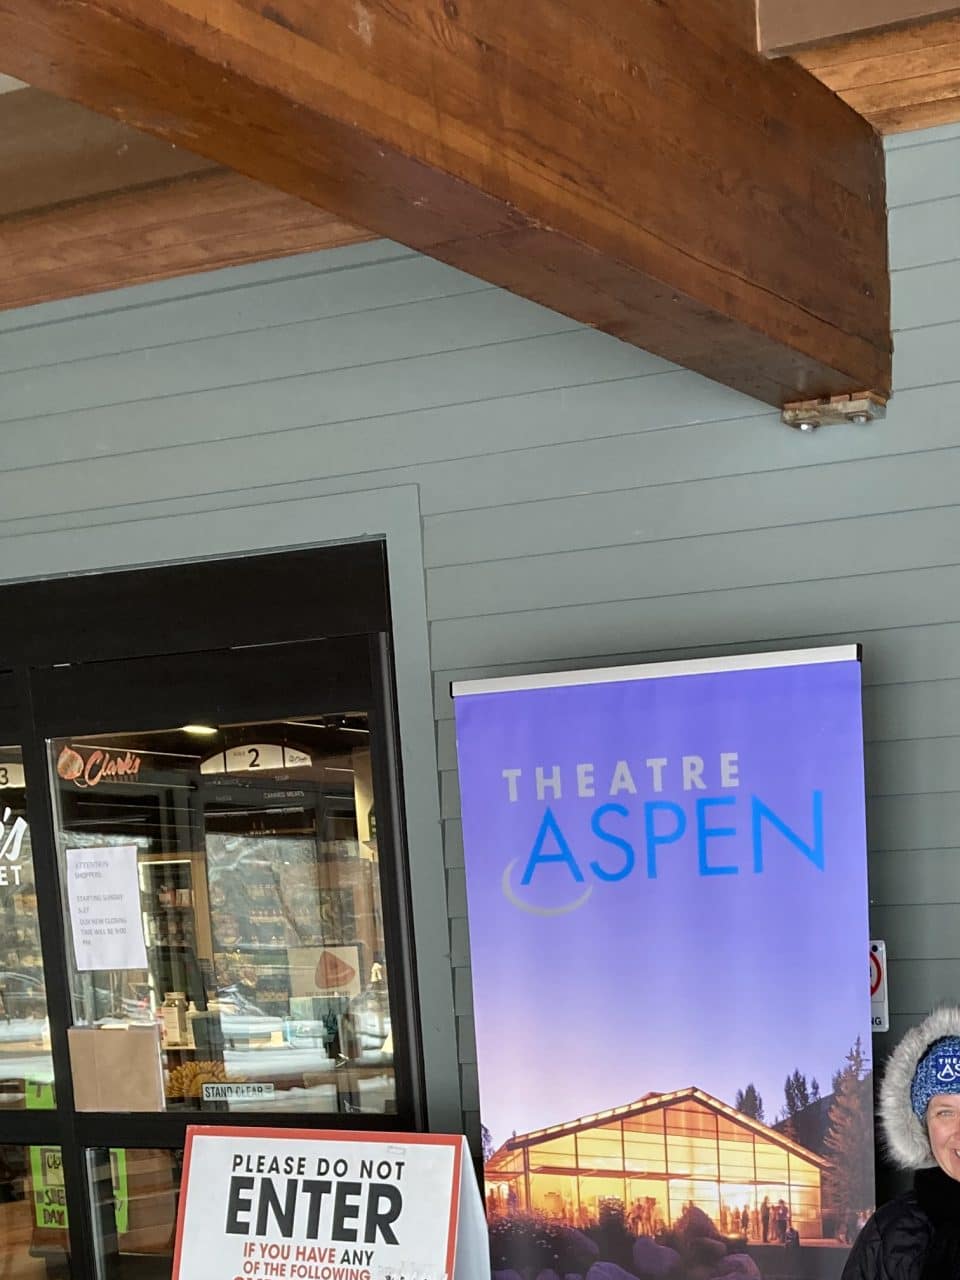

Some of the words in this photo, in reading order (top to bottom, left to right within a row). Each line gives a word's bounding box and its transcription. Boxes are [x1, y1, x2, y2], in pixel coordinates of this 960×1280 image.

[85, 750, 141, 786] Clark's
[248, 748, 260, 767] 2
[502, 753, 740, 802] THEATRE
[521, 790, 824, 887] ASPEN
[232, 1154, 306, 1176] PLEASE
[317, 1158, 348, 1178] DO
[360, 1160, 405, 1181] NOT
[225, 1176, 403, 1245] ENTER
[243, 1242, 256, 1258] IF
[260, 1244, 290, 1260] YOU
[296, 1246, 336, 1264] HAVE
[340, 1250, 374, 1267] ANY
[243, 1261, 261, 1275] OF
[264, 1262, 286, 1277] THE
